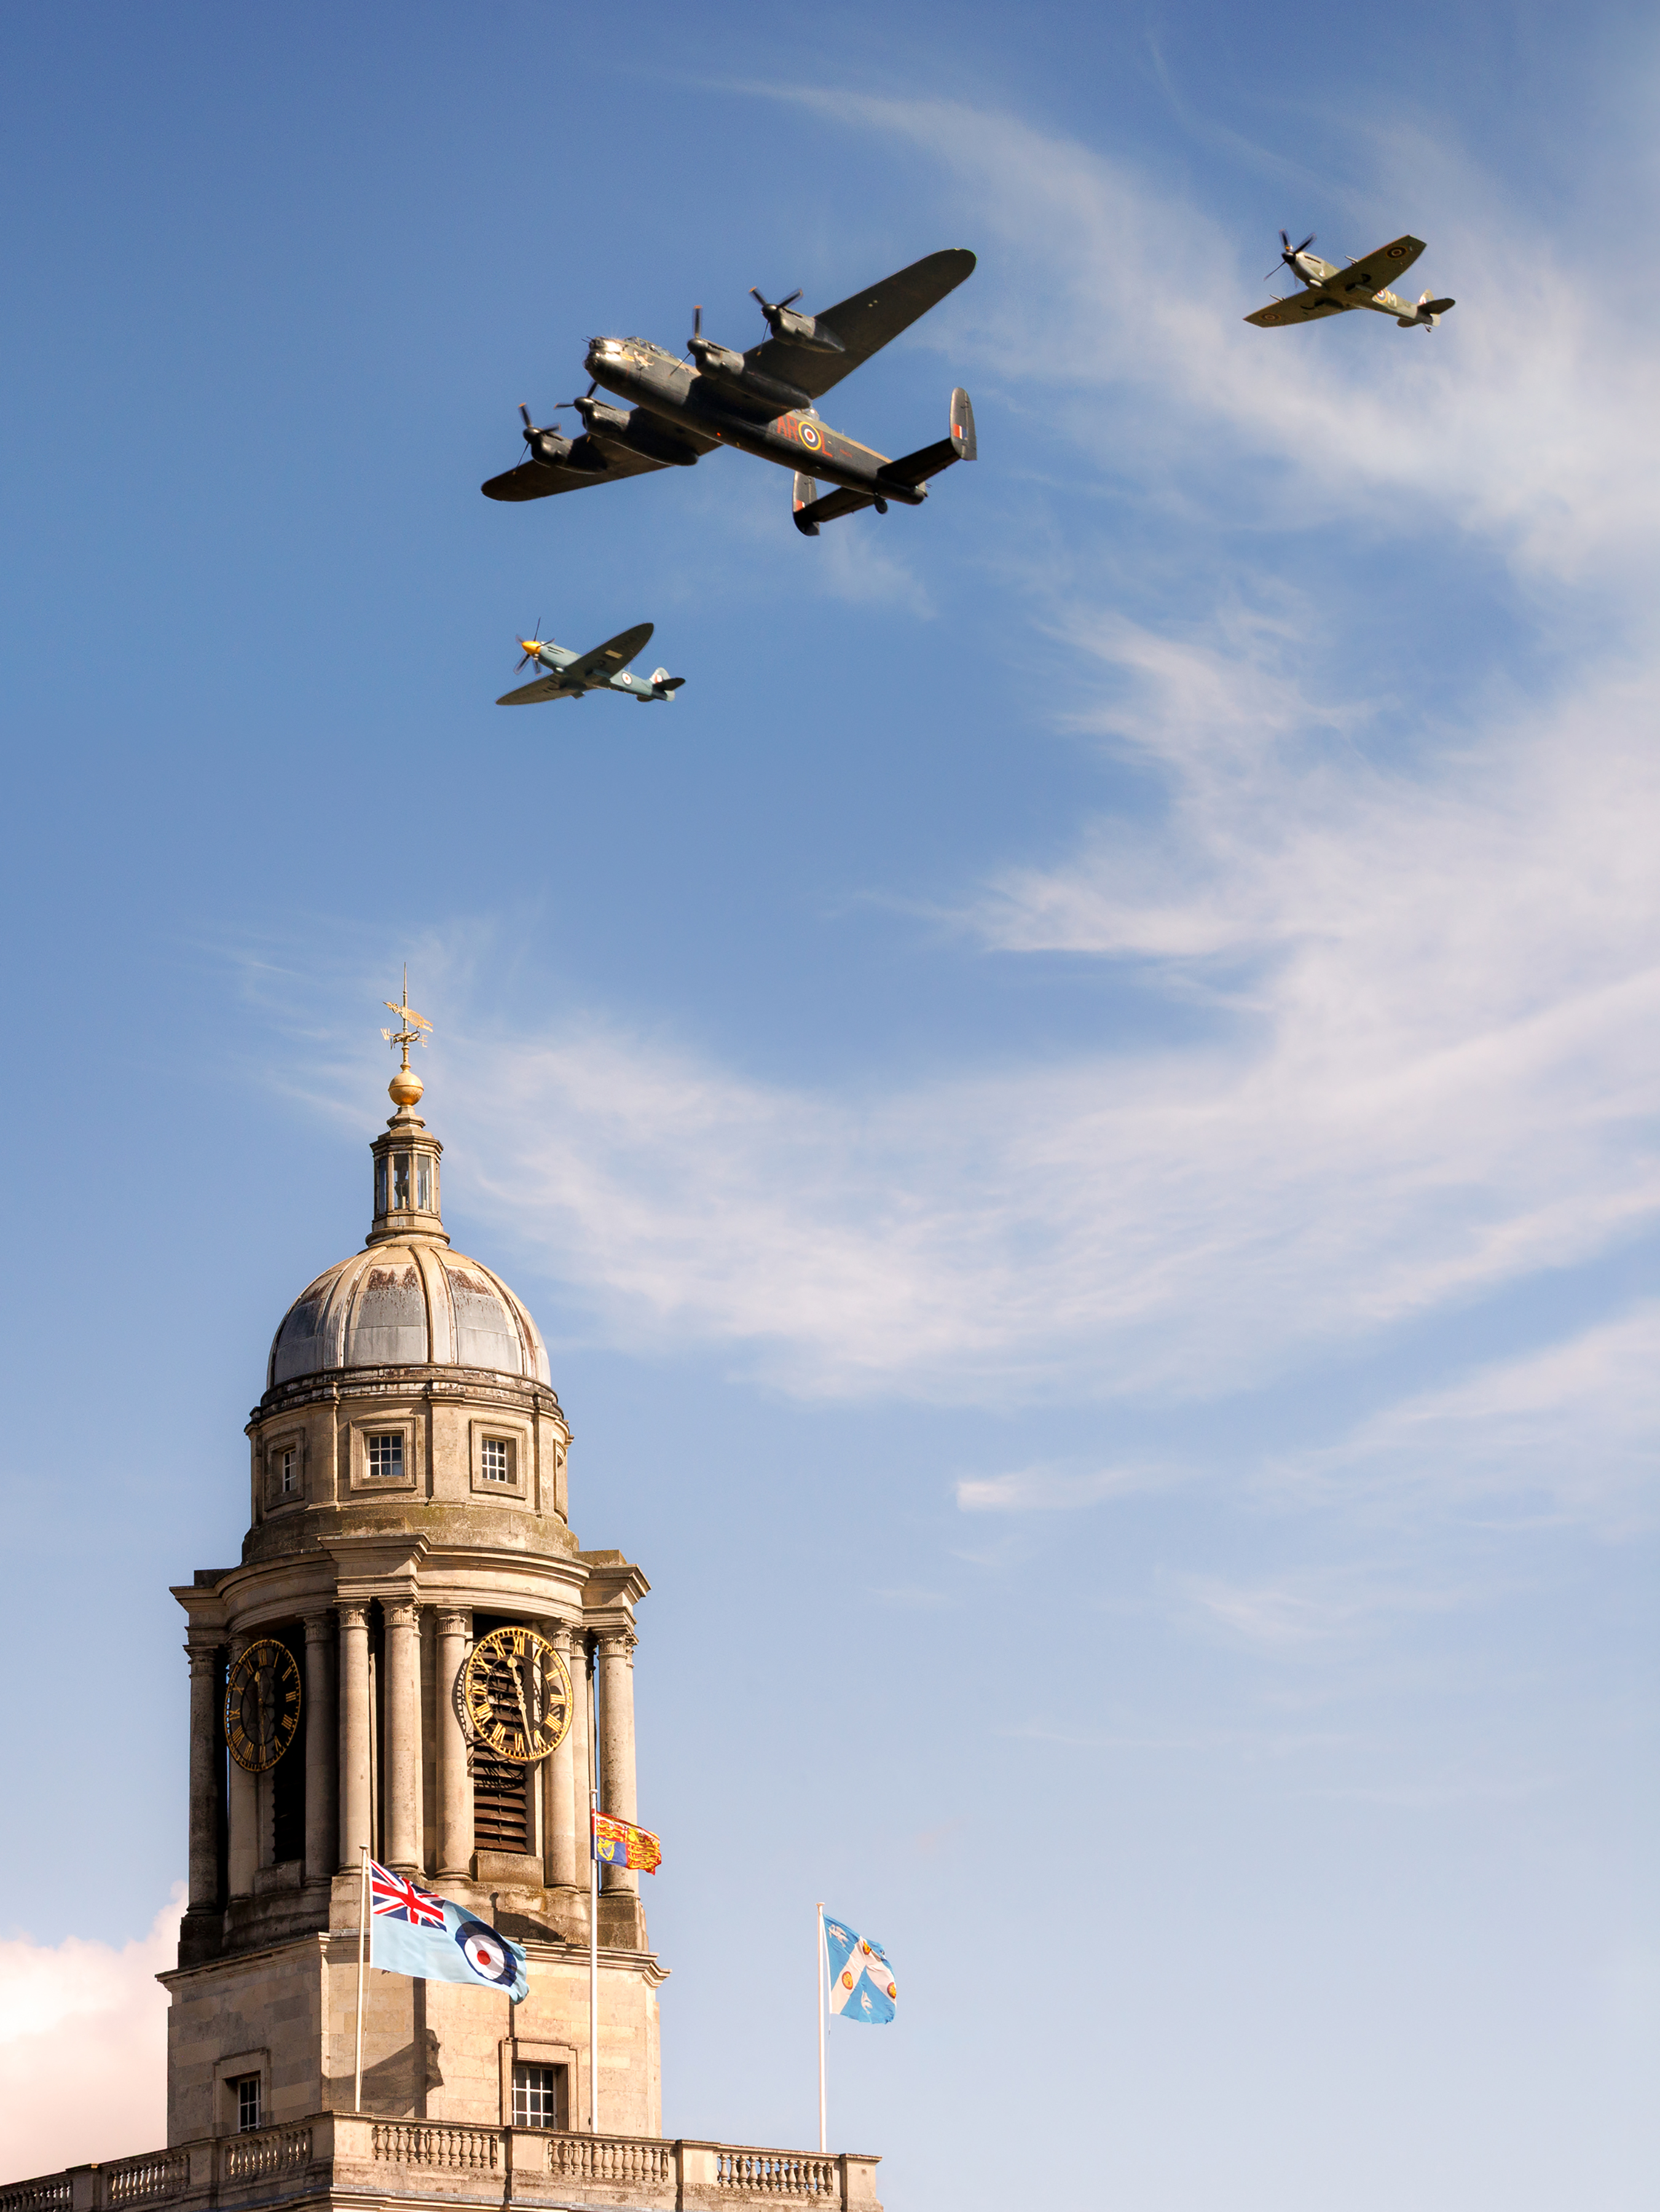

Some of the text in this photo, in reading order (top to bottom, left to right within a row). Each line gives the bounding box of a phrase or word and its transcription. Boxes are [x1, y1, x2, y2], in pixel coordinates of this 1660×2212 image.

[1387, 291, 1397, 307] M
[777, 414, 833, 457] AR L
[380, 1028, 390, 1040] W
[422, 1035, 427, 1047] E
